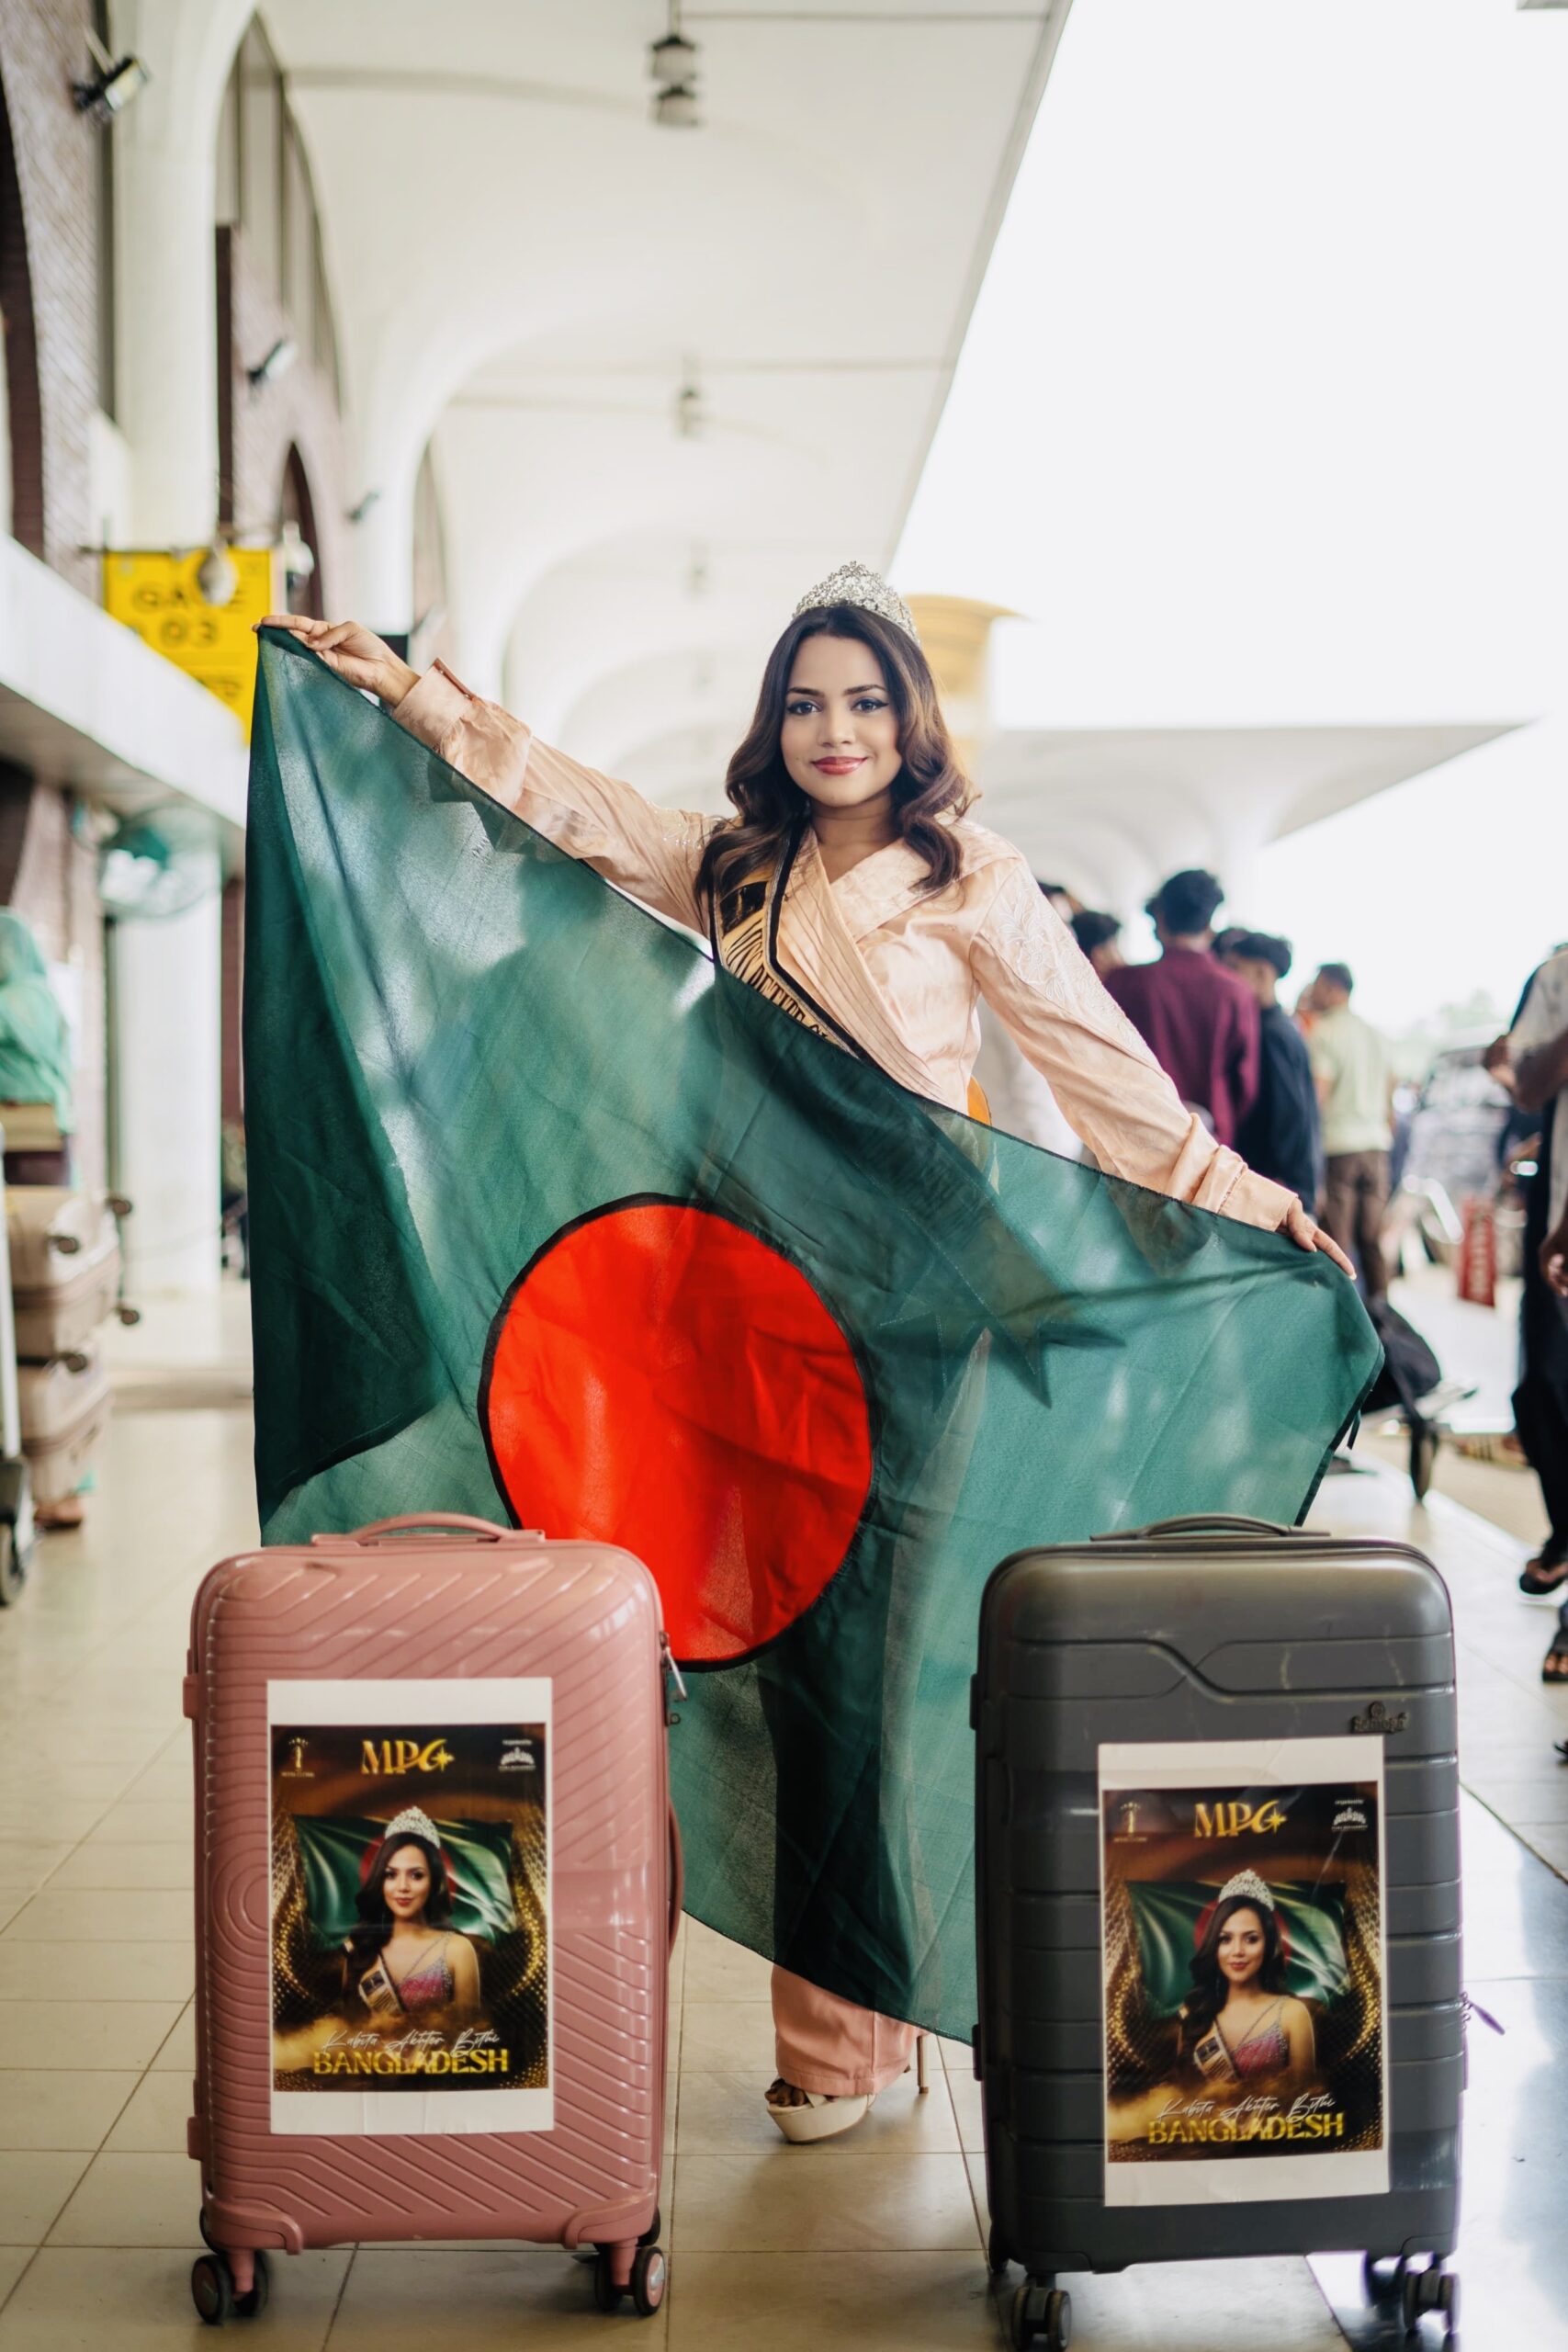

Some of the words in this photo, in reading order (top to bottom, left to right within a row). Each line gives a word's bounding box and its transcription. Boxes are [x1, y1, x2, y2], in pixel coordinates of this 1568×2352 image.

[361, 1738, 454, 1774] MPG
[1194, 1800, 1286, 1837] MPG
[314, 2049, 508, 2075] BANGLADESH
[1149, 2112, 1344, 2143] BANGLADESH
